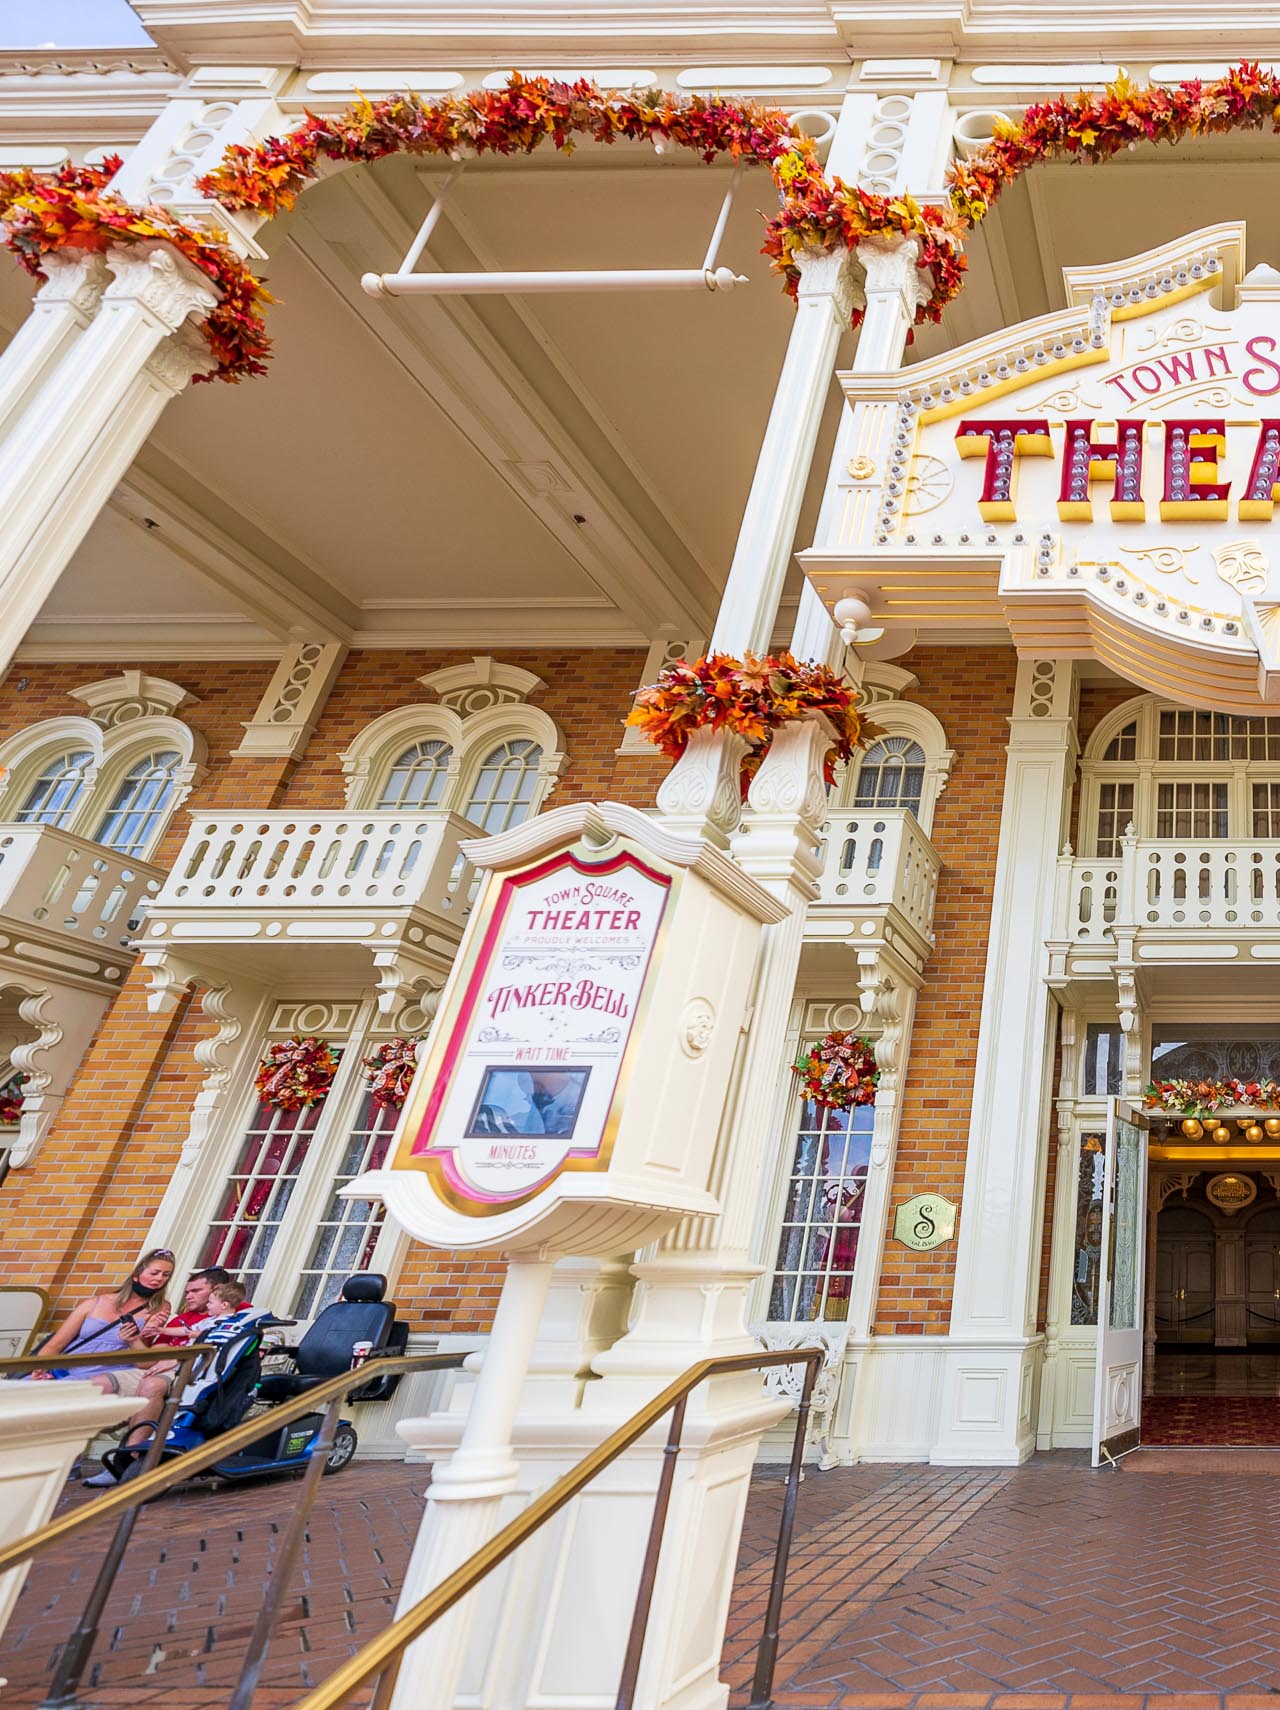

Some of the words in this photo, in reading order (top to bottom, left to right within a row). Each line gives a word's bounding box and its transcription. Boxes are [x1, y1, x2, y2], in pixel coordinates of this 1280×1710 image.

[1105, 346, 1232, 404] TOWN
[544, 886, 581, 908] TOWN
[581, 882, 635, 908] SQUARE
[527, 910, 641, 930] THEATER
[524, 936, 571, 944] PROUDLY
[574, 936, 630, 944] WELCOMES
[515, 1047, 544, 1061] WAIT
[545, 1047, 570, 1061] TIME
[488, 1145, 537, 1160] MINUTES
[913, 1204, 936, 1239] S
